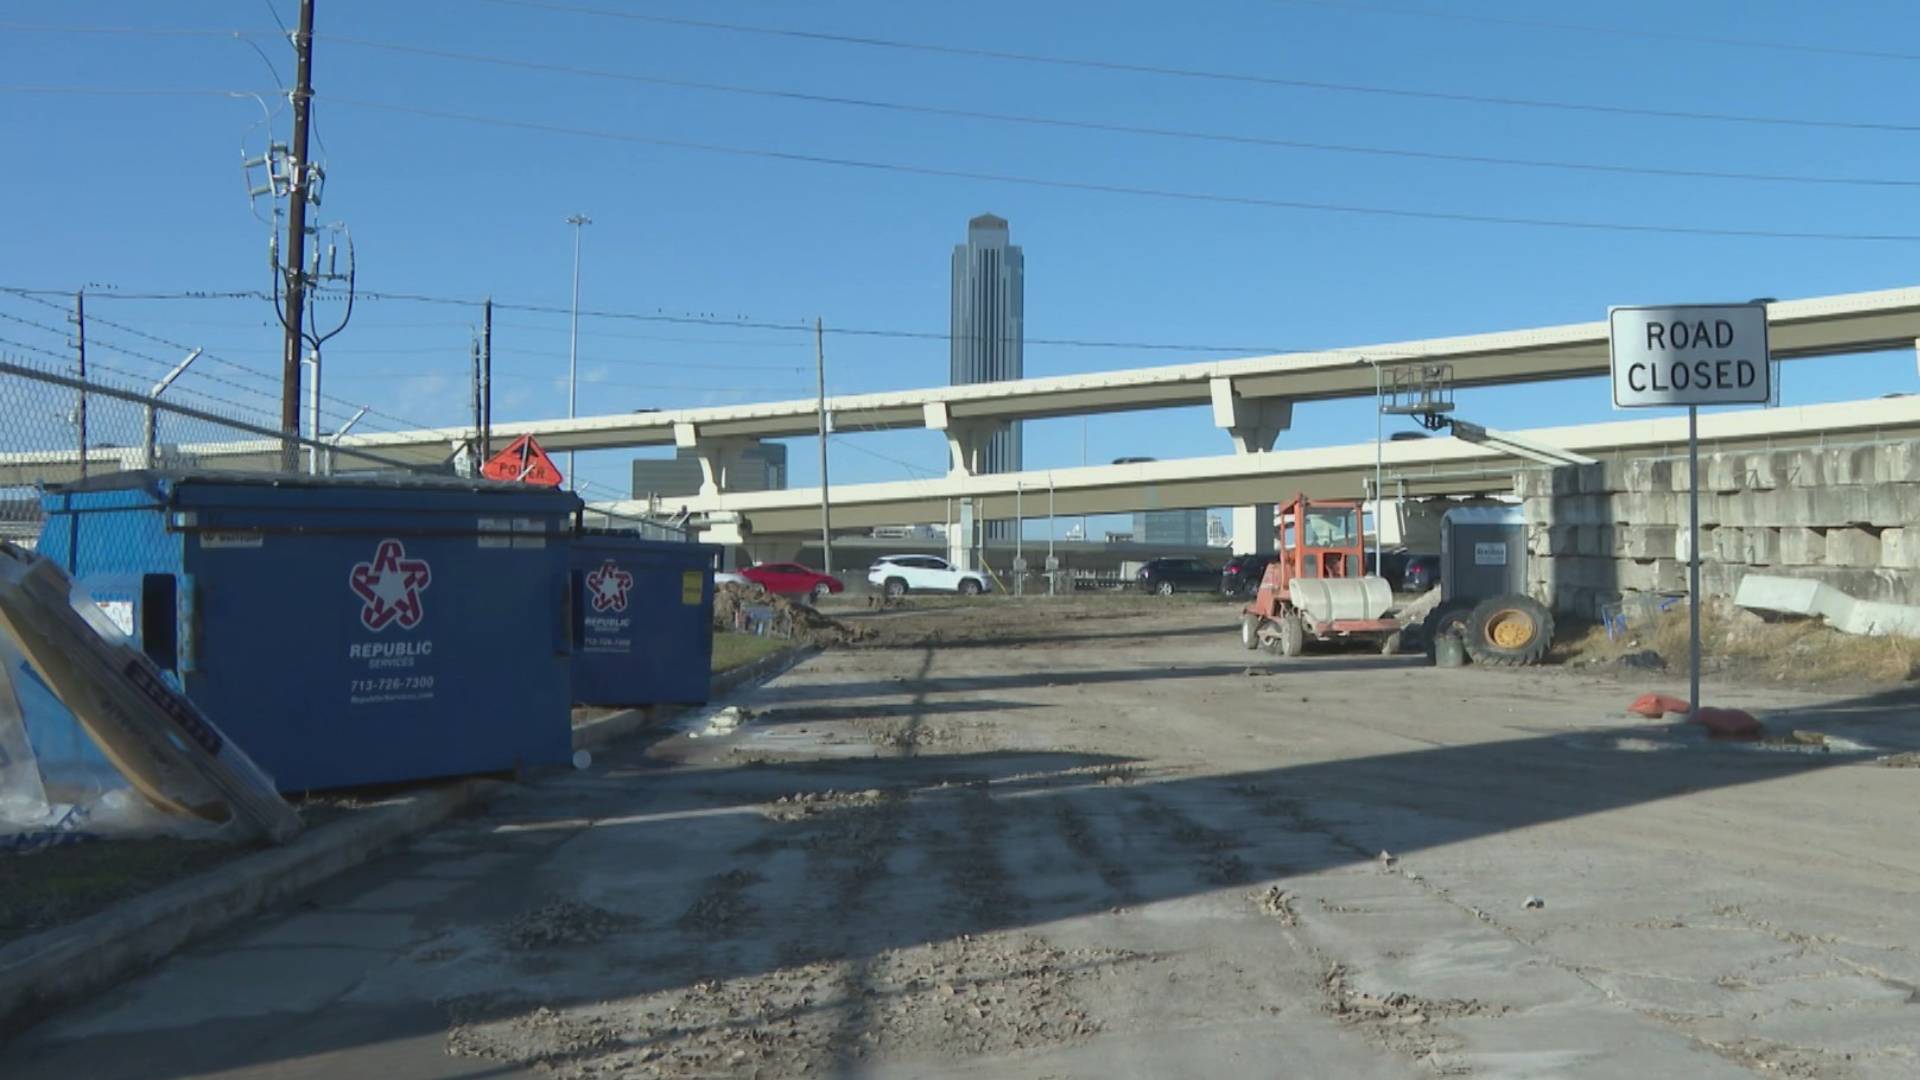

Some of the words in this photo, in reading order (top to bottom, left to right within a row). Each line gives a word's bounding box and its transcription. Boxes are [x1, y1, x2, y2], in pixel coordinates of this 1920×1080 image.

[1646, 319, 1734, 350] ROAD
[1628, 360, 1755, 392] CLOSED
[499, 462, 545, 479] POER
[349, 640, 433, 658] REPUBLIC
[368, 657, 415, 669] SERVICES
[351, 675, 434, 692] 713-726-7300
